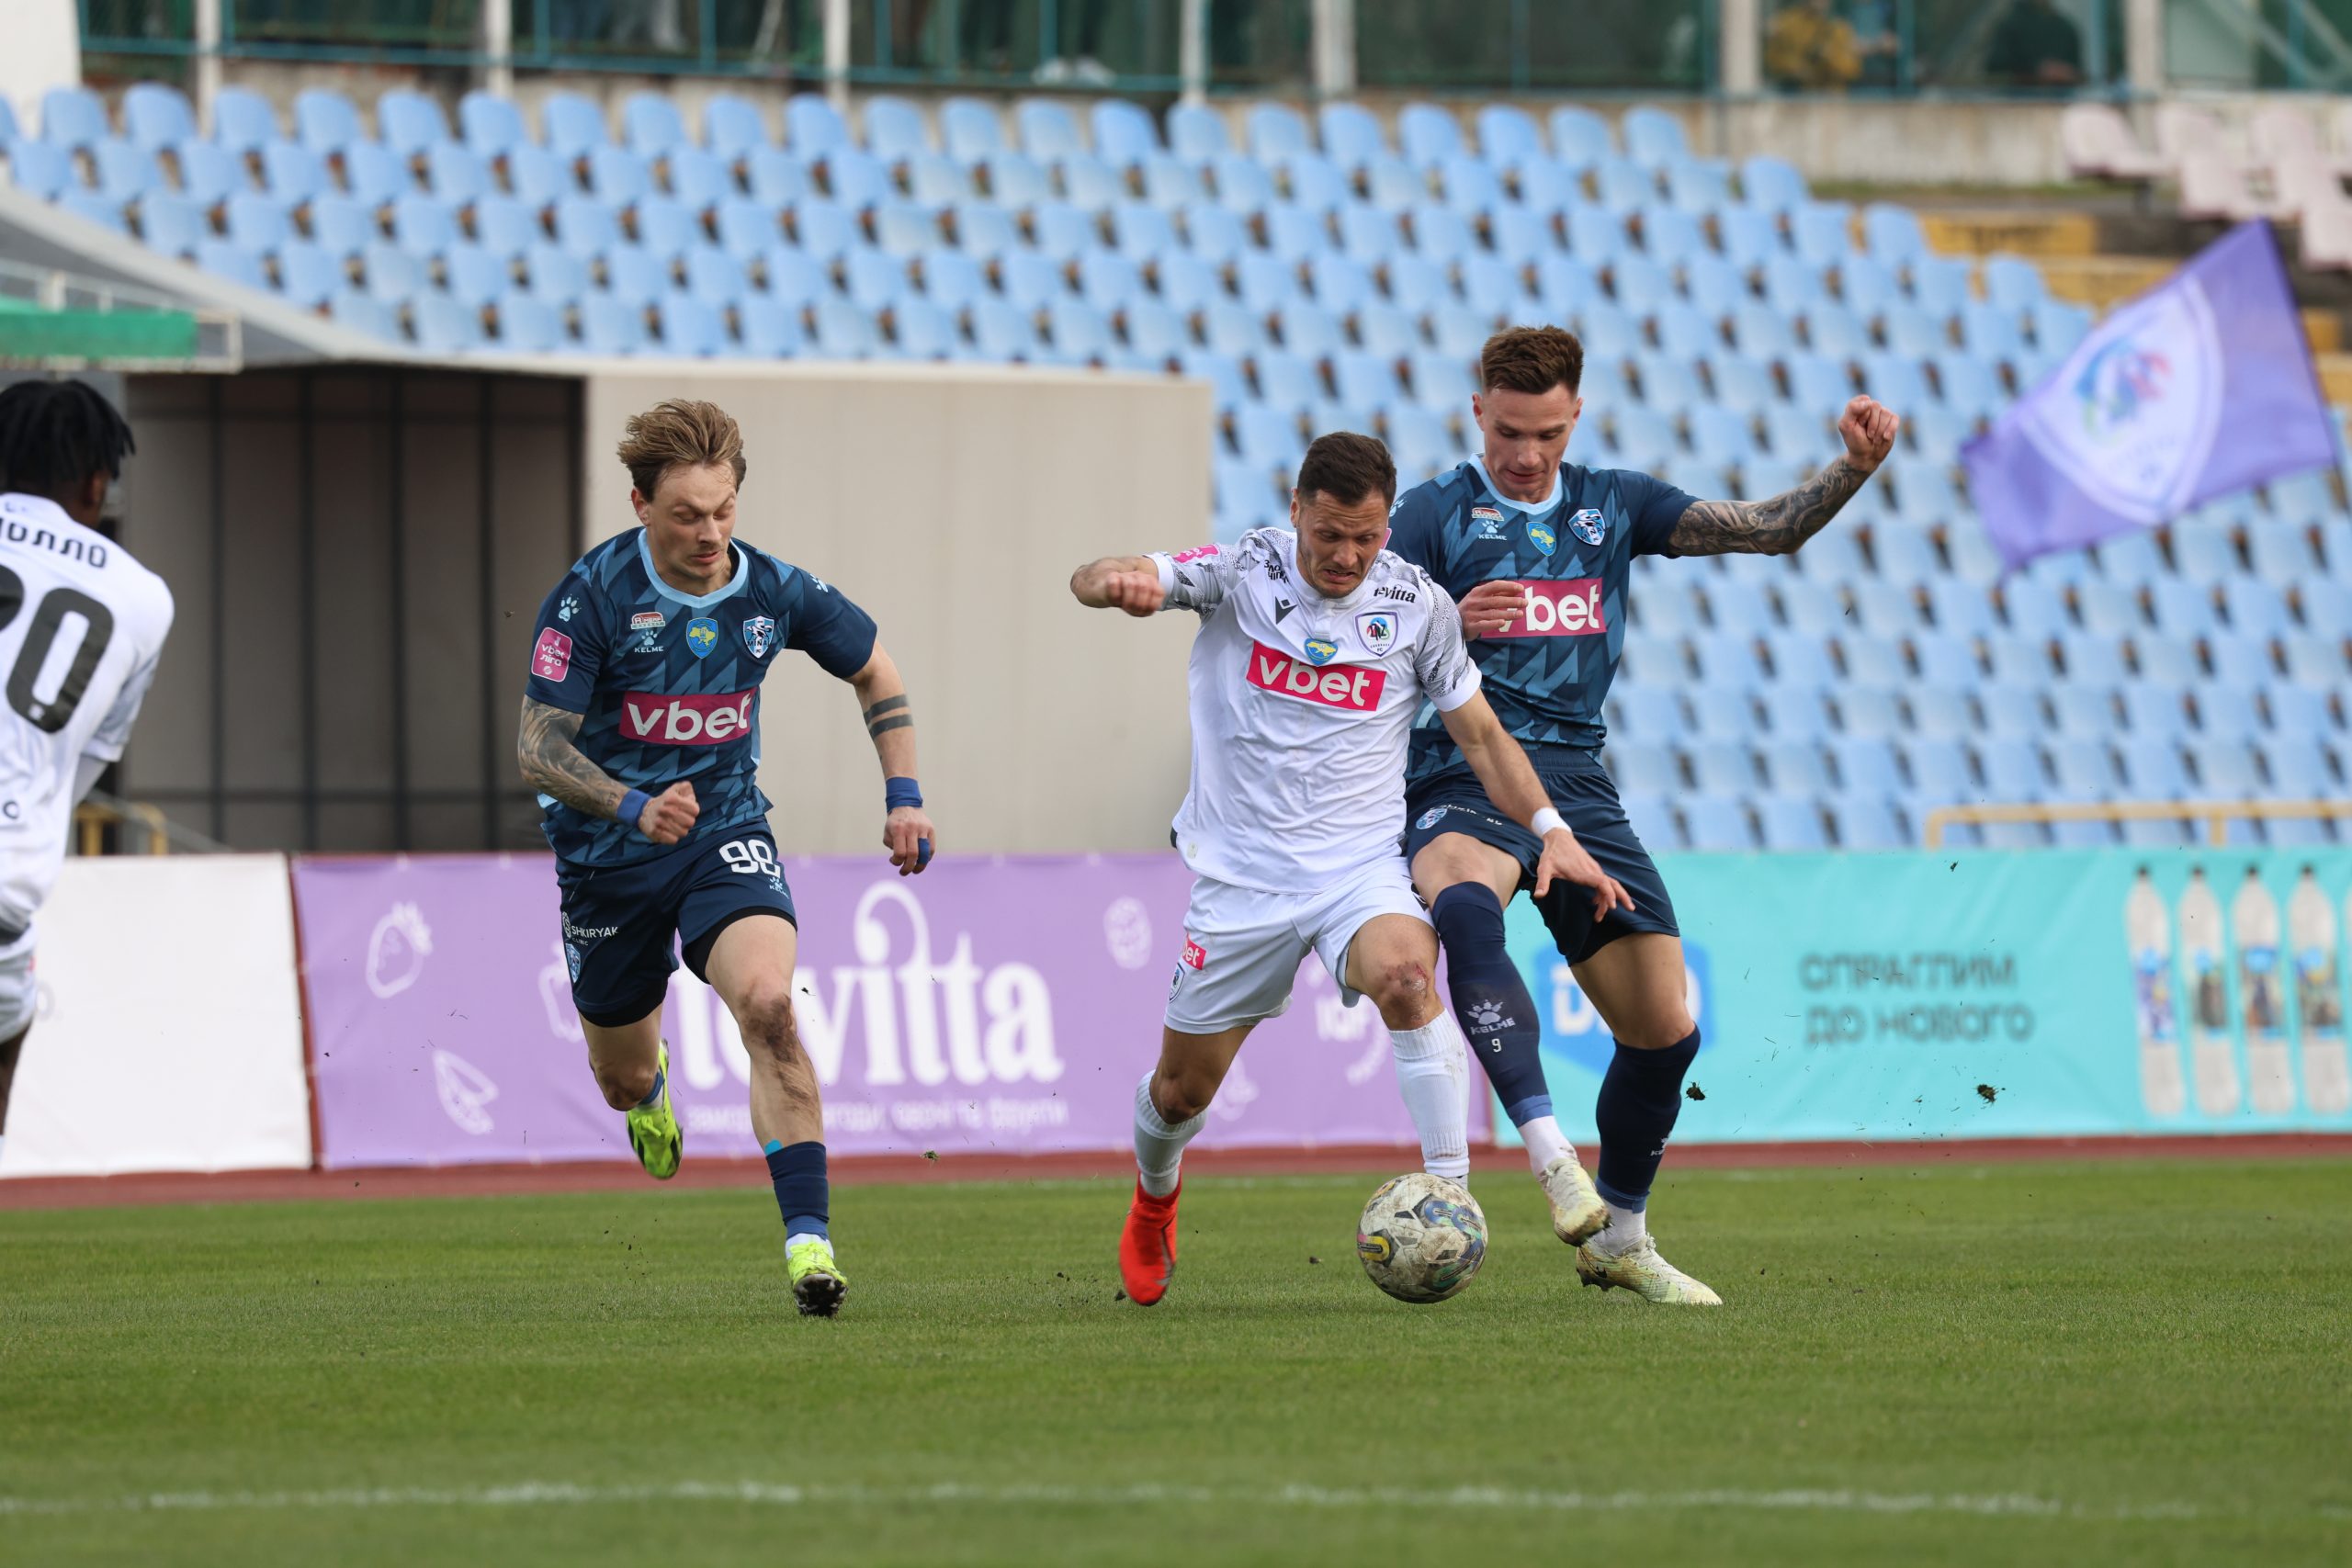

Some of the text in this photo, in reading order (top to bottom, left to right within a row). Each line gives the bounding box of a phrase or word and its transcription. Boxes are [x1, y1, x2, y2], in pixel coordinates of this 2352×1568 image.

[0, 516, 107, 570] ОЛЛО
[0, 561, 115, 734] 0
[1260, 654, 1371, 706] vbet
[628, 693, 751, 740] vbet
[718, 839, 781, 879] 98
[571, 925, 618, 938] SHKIRYAK
[571, 938, 589, 946] CLINIC
[1470, 1017, 1516, 1035] KELME
[1804, 1002, 2036, 1044] ДО НОВОГО
[1491, 1038, 1502, 1053] 9
